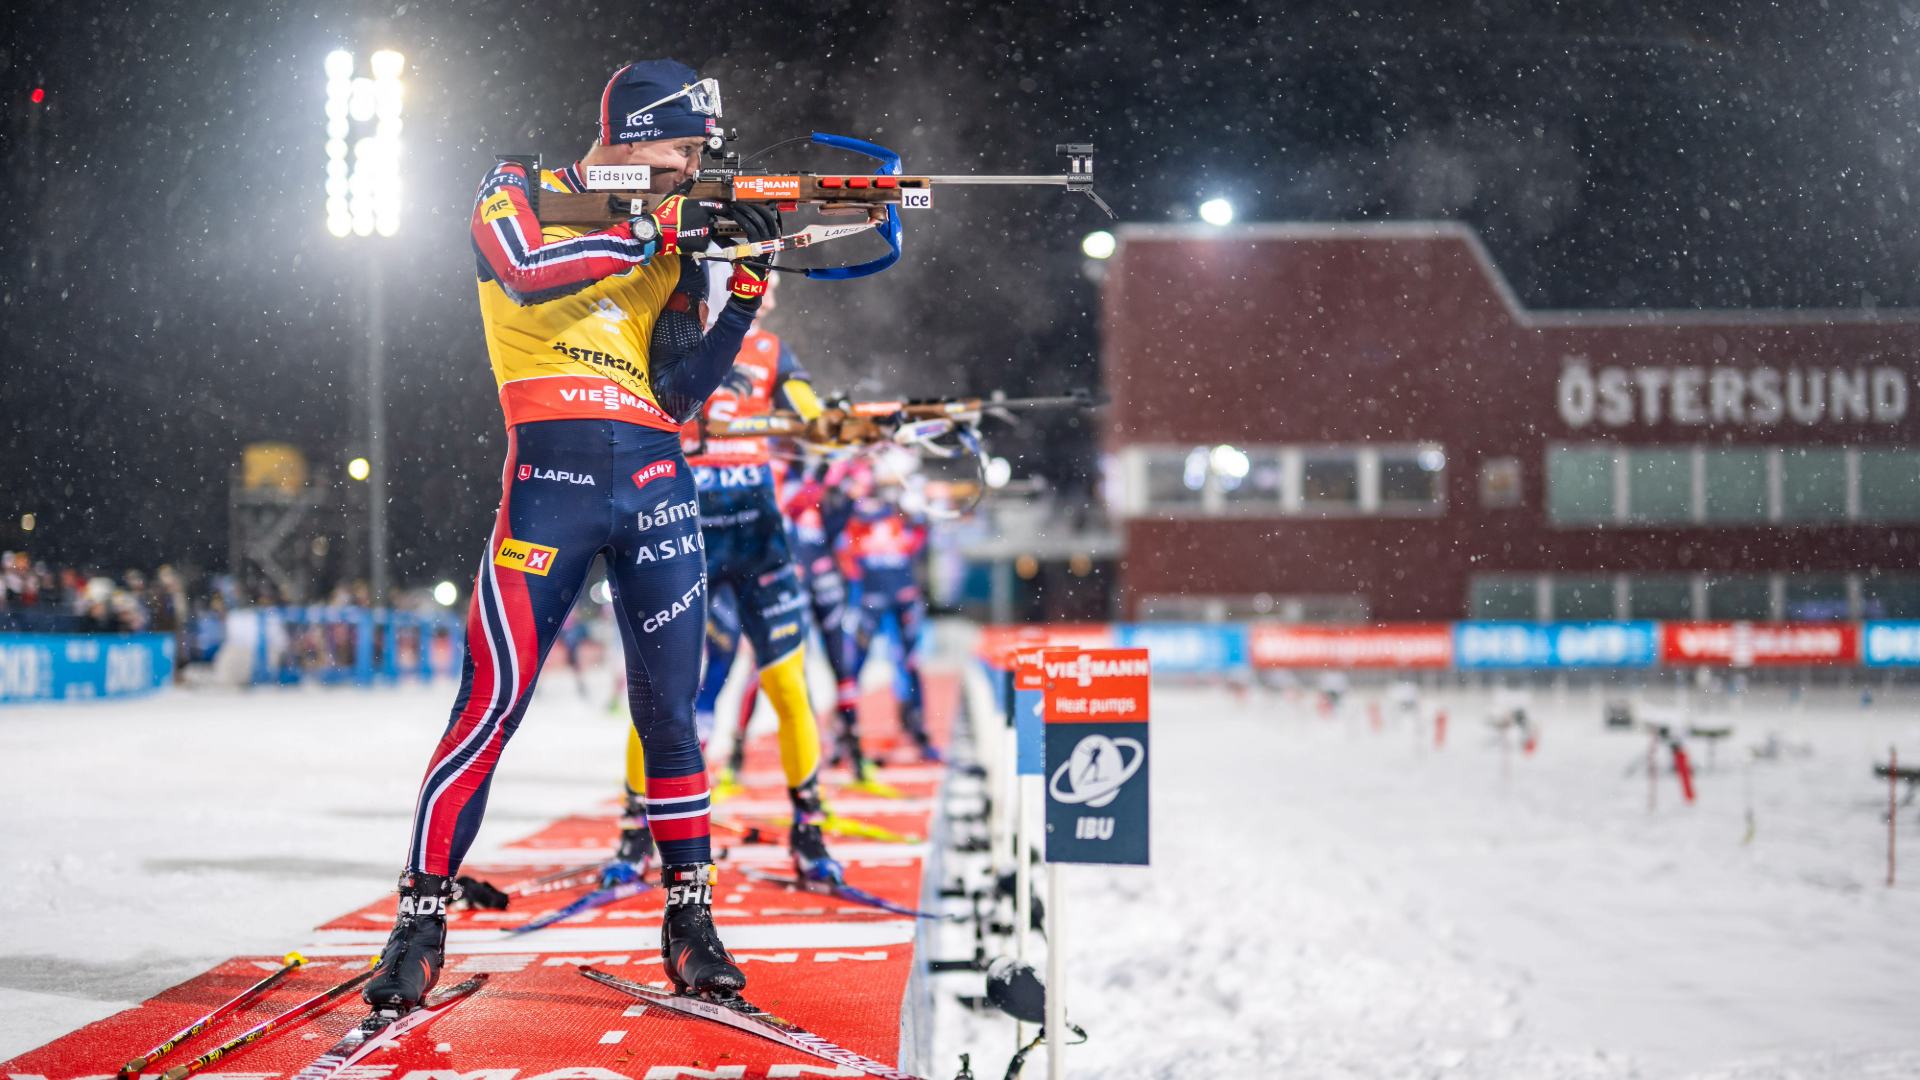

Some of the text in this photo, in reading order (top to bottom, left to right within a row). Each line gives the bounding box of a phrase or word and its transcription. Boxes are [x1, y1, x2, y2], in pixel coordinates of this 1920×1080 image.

[620, 130, 653, 139] CRAFT
[735, 178, 798, 193] VIESSMANN
[904, 190, 929, 207] ice
[734, 281, 763, 293] LEKI
[603, 322, 620, 335] IBU
[1559, 355, 1909, 427] ÖSTERSUND
[534, 467, 595, 486] LAPUA
[638, 464, 672, 483] MENY
[501, 547, 525, 561] Uno
[642, 580, 701, 633] CRAFT
[1045, 654, 1149, 687] VIESSMANN
[1056, 697, 1137, 716] Heat pumps
[1075, 816, 1115, 841] IBU
